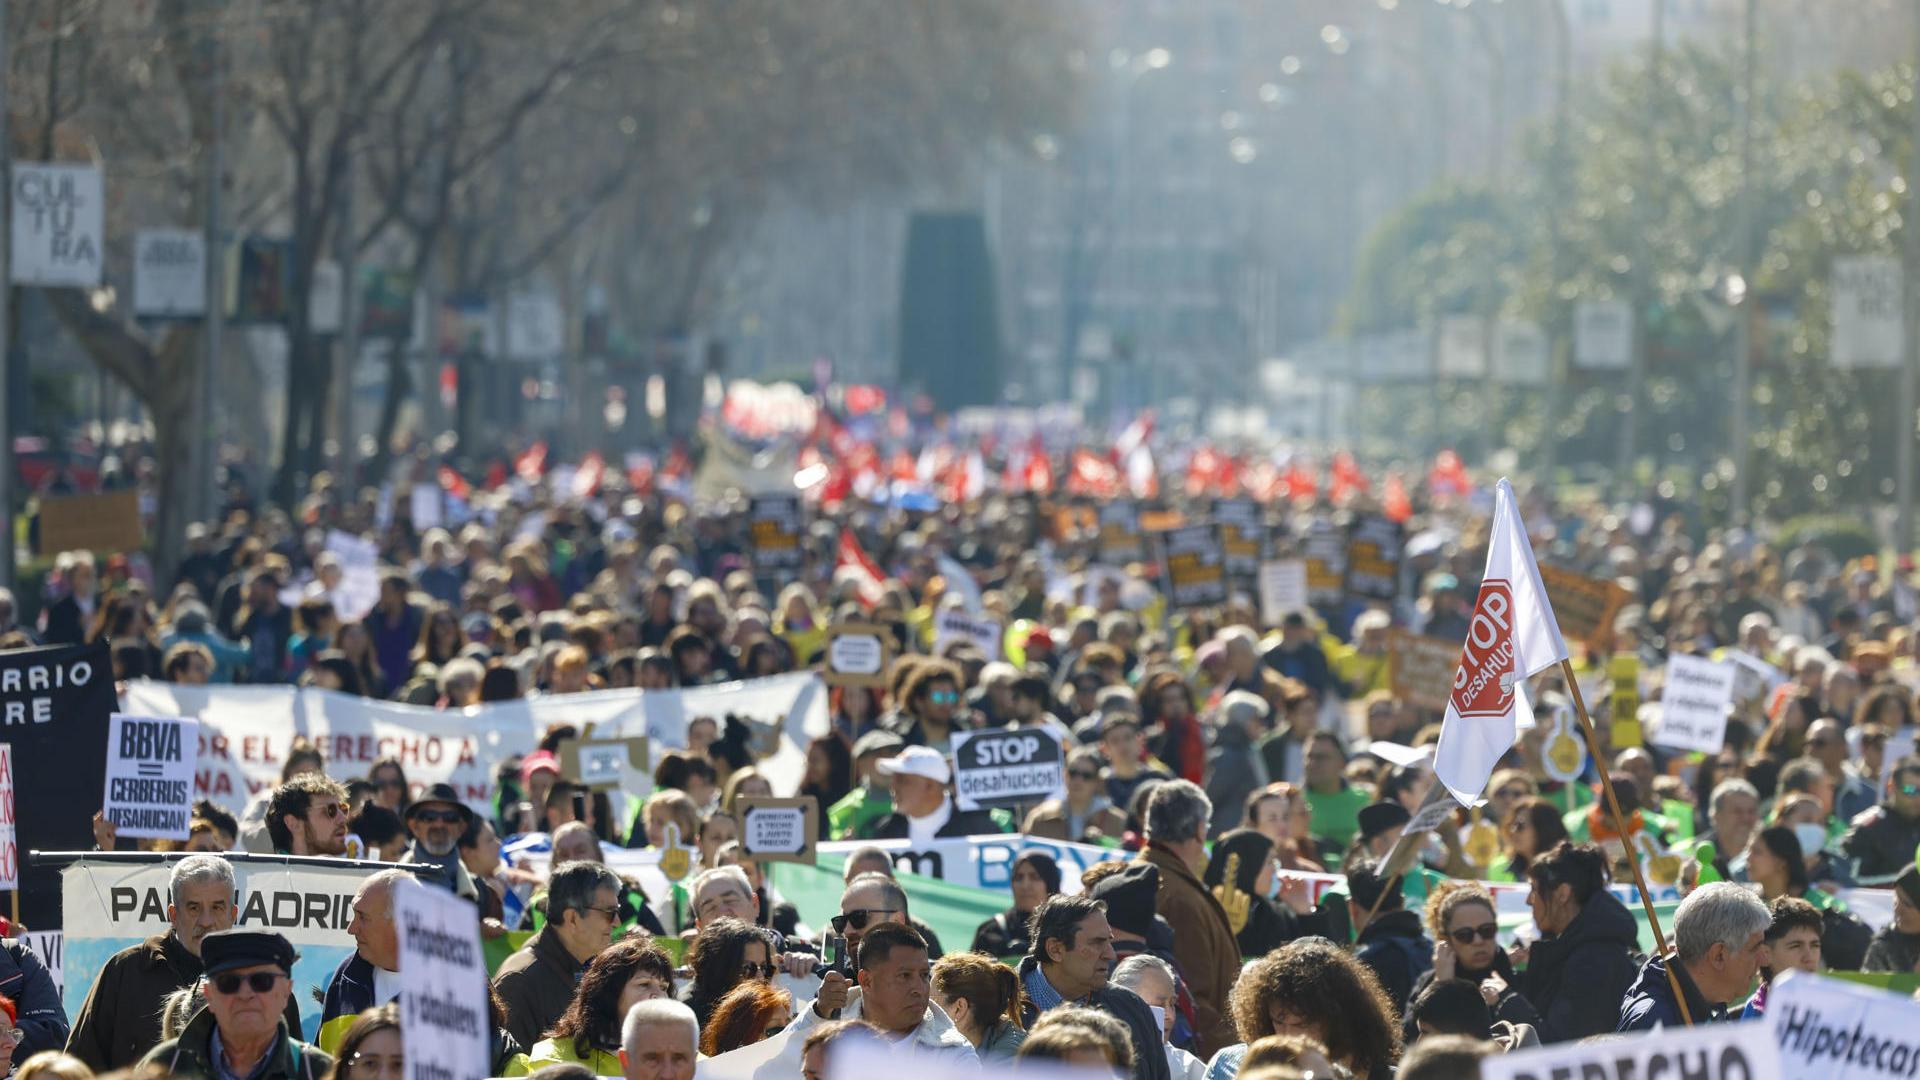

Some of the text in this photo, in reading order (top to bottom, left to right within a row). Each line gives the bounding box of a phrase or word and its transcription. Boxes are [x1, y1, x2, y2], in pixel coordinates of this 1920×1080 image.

[2, 661, 92, 692] RRIO
[5, 697, 52, 726] RE
[119, 721, 182, 762] BBVA
[243, 733, 277, 763] EL
[295, 732, 443, 768] ERECHO
[458, 737, 476, 768] A
[975, 736, 1040, 766] STOP
[110, 778, 188, 806] CERBERUS
[108, 807, 186, 832] DESAHUCIAN
[111, 887, 356, 930] PA ADRI
